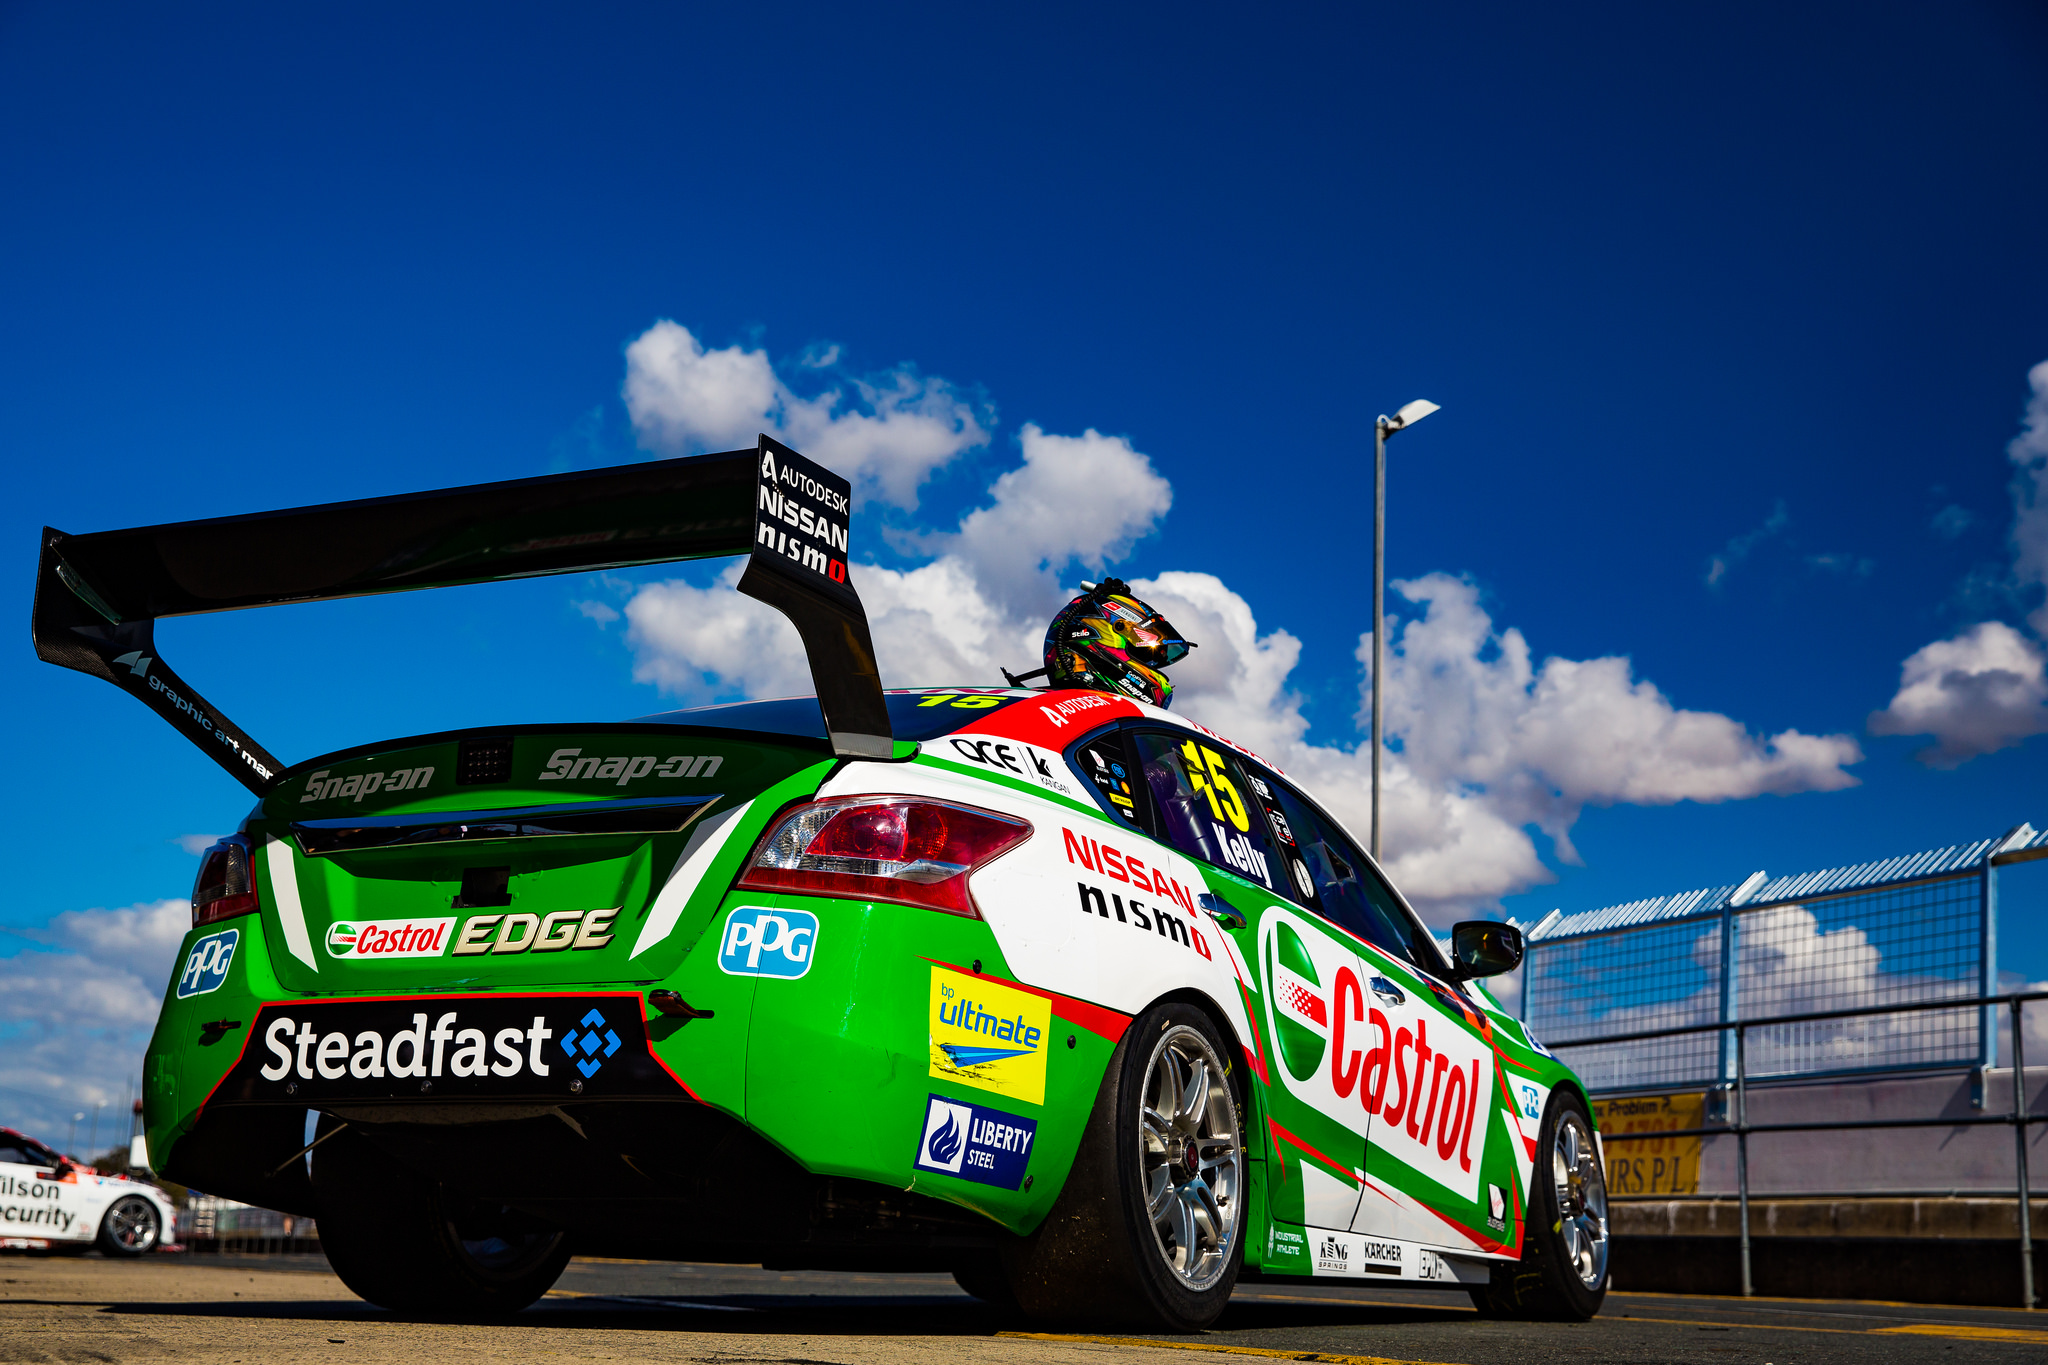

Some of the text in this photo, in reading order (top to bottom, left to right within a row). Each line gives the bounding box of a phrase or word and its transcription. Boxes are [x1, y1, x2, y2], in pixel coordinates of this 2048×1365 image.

[780, 465, 848, 516] AUTODESK
[759, 484, 848, 553] NISSAN
[757, 522, 846, 584] nismo
[1127, 670, 1147, 686] GoPro
[917, 694, 1008, 709] 15
[1055, 695, 1111, 717] AUTODESK
[148, 675, 274, 780] graphic art mar
[299, 765, 436, 803] Snap-on
[537, 748, 725, 786] Snap-on
[1039, 776, 1071, 795] KANGAN
[1181, 739, 1249, 832] 15
[1062, 826, 1198, 919] NISSAN
[1211, 821, 1273, 890] Kelly
[356, 906, 623, 957] Castrol EDGE
[725, 914, 813, 968] PPG
[1077, 881, 1212, 962] nismo
[182, 939, 234, 990] PPG
[940, 982, 955, 1000] bp
[939, 998, 1042, 1049] ultimate
[260, 1012, 553, 1082] Steadfast
[1331, 965, 1480, 1174] Castrol
[971, 1118, 1033, 1155] LIBERTY
[966, 1149, 995, 1171] STEEL
[0, 1175, 60, 1200] ilson
[1275, 1230, 1304, 1243] INDUSTRIAL
[1276, 1244, 1300, 1256] ATHLETE
[1320, 1237, 1349, 1261] KING
[1318, 1261, 1348, 1270] SPRINGS
